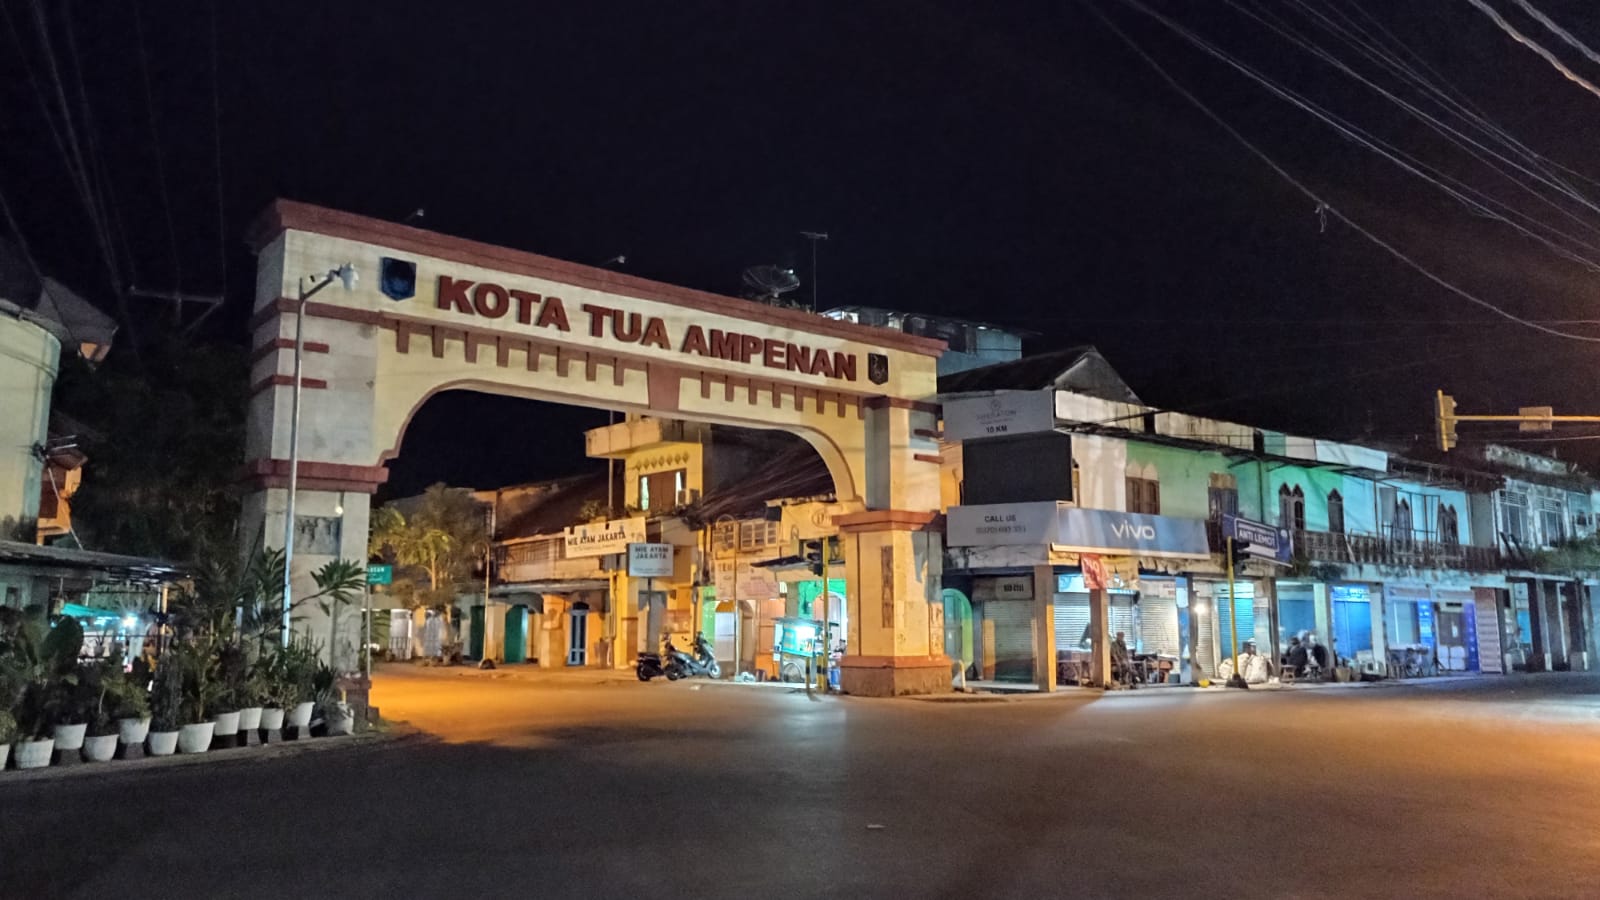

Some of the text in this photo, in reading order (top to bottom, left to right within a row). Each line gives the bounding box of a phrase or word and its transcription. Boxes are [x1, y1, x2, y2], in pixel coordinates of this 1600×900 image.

[437, 275, 857, 382] KOTA TUA AMPENAN
[1006, 514, 1017, 522] US
[567, 531, 626, 546] MIE AYAM JAKARTA
[1111, 520, 1156, 540] vivo
[1239, 529, 1254, 542] ANTI
[1254, 532, 1275, 547] LEMOT
